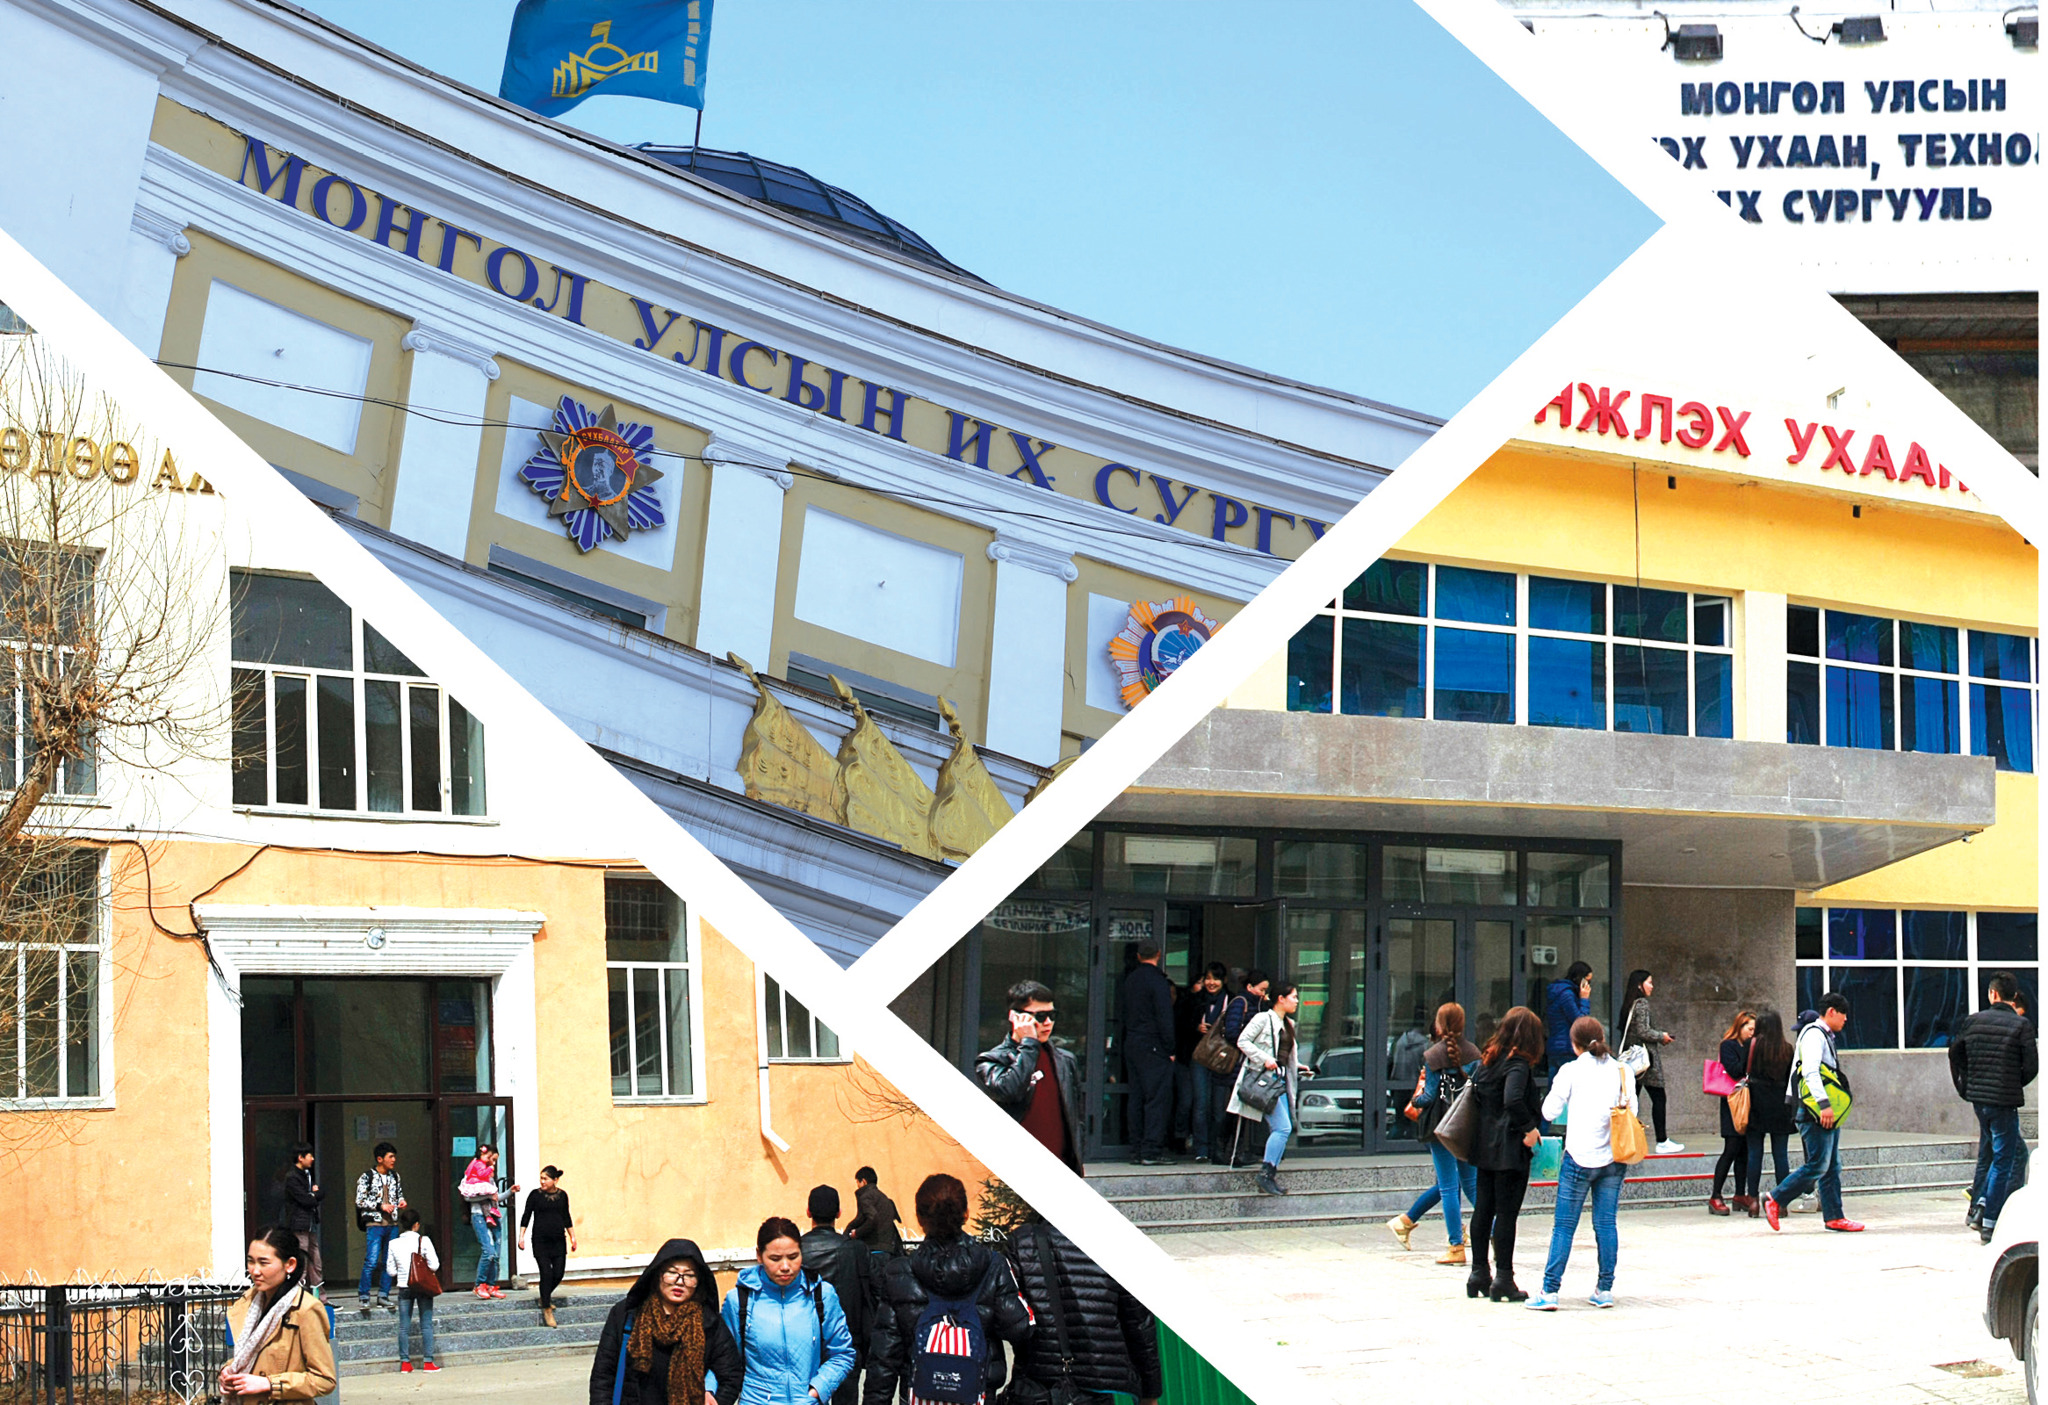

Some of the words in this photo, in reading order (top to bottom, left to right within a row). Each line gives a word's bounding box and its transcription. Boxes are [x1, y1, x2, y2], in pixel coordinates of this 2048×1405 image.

[1681, 81, 1845, 115] МОНГОЛ
[1865, 79, 2006, 113] УЛСЫН
[1730, 135, 1881, 181] УХААН,
[1898, 132, 2039, 167] ТЕХНО
[1783, 187, 1992, 223] СУРГУУЛЬ
[236, 134, 591, 328] МОНГОЛ
[630, 297, 909, 442] УЛСЫН
[942, 410, 1056, 492] ИХ
